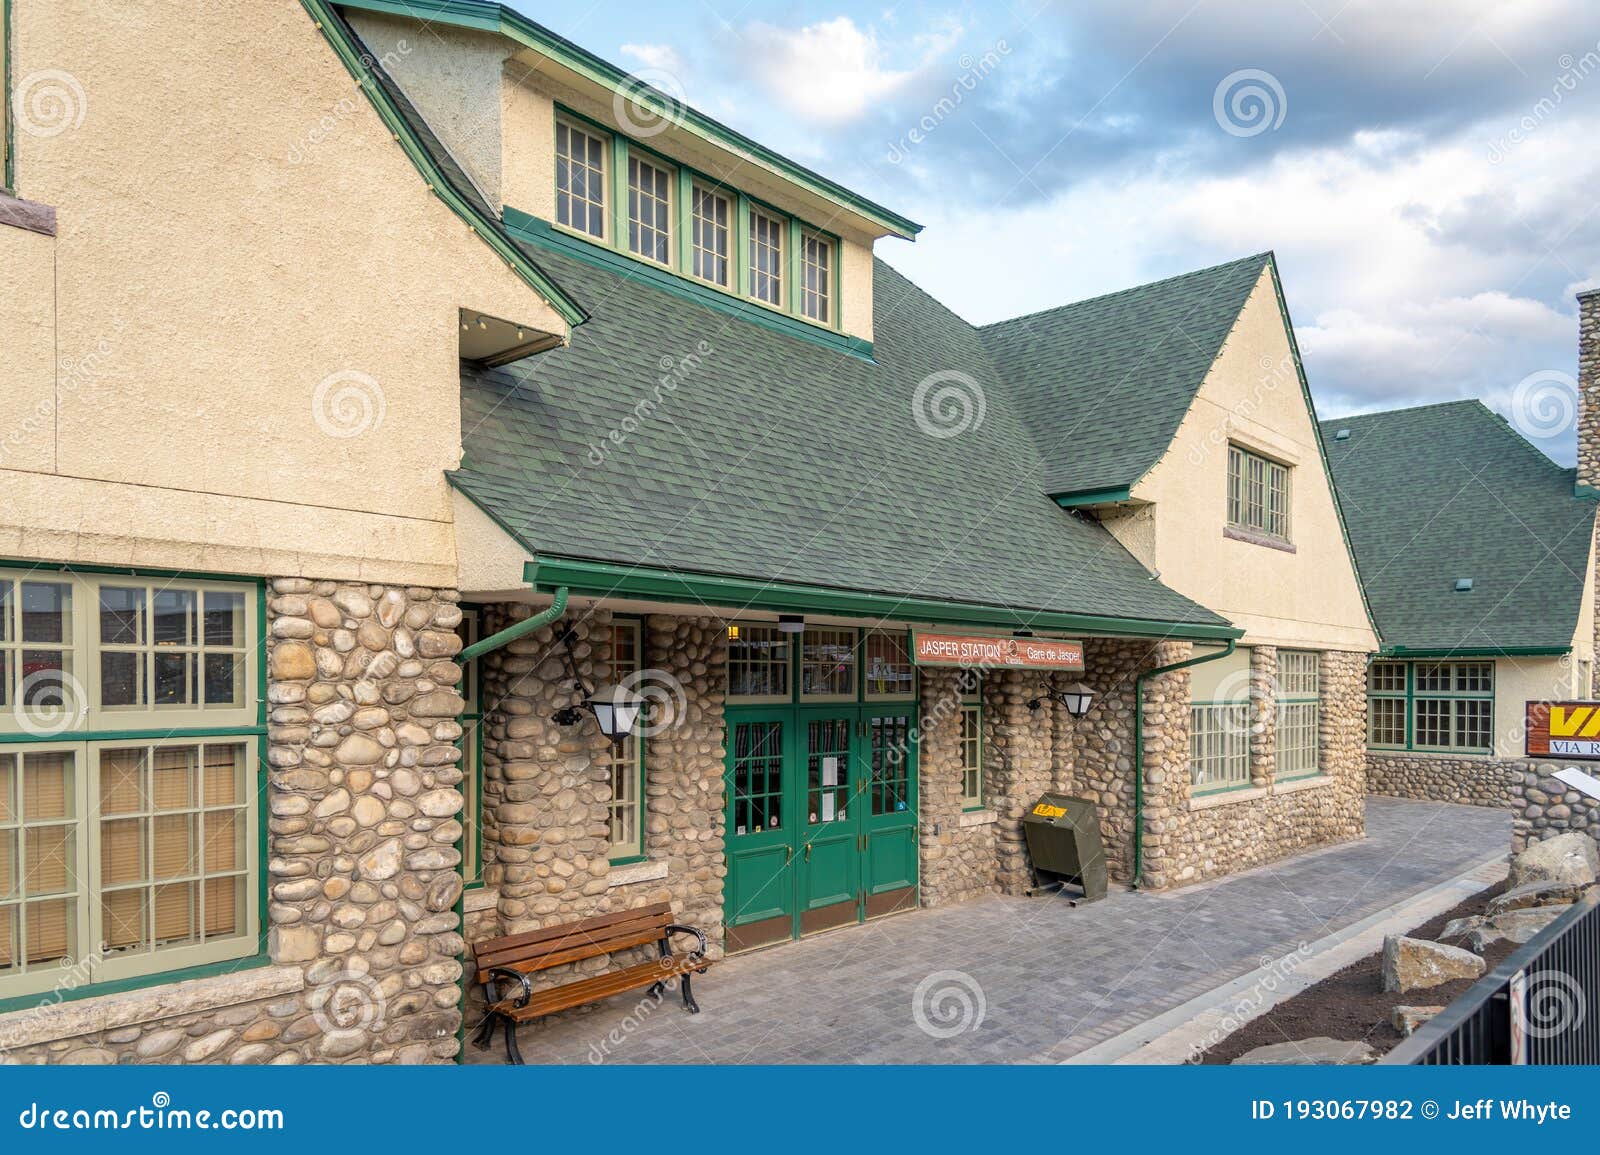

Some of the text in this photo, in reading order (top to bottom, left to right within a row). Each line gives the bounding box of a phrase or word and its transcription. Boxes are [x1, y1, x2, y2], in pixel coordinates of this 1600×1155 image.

[920, 640, 1000, 658] JASPER STATION
[1027, 647, 1080, 663] Gare de Jasper
[1552, 741, 1582, 753] VIA
